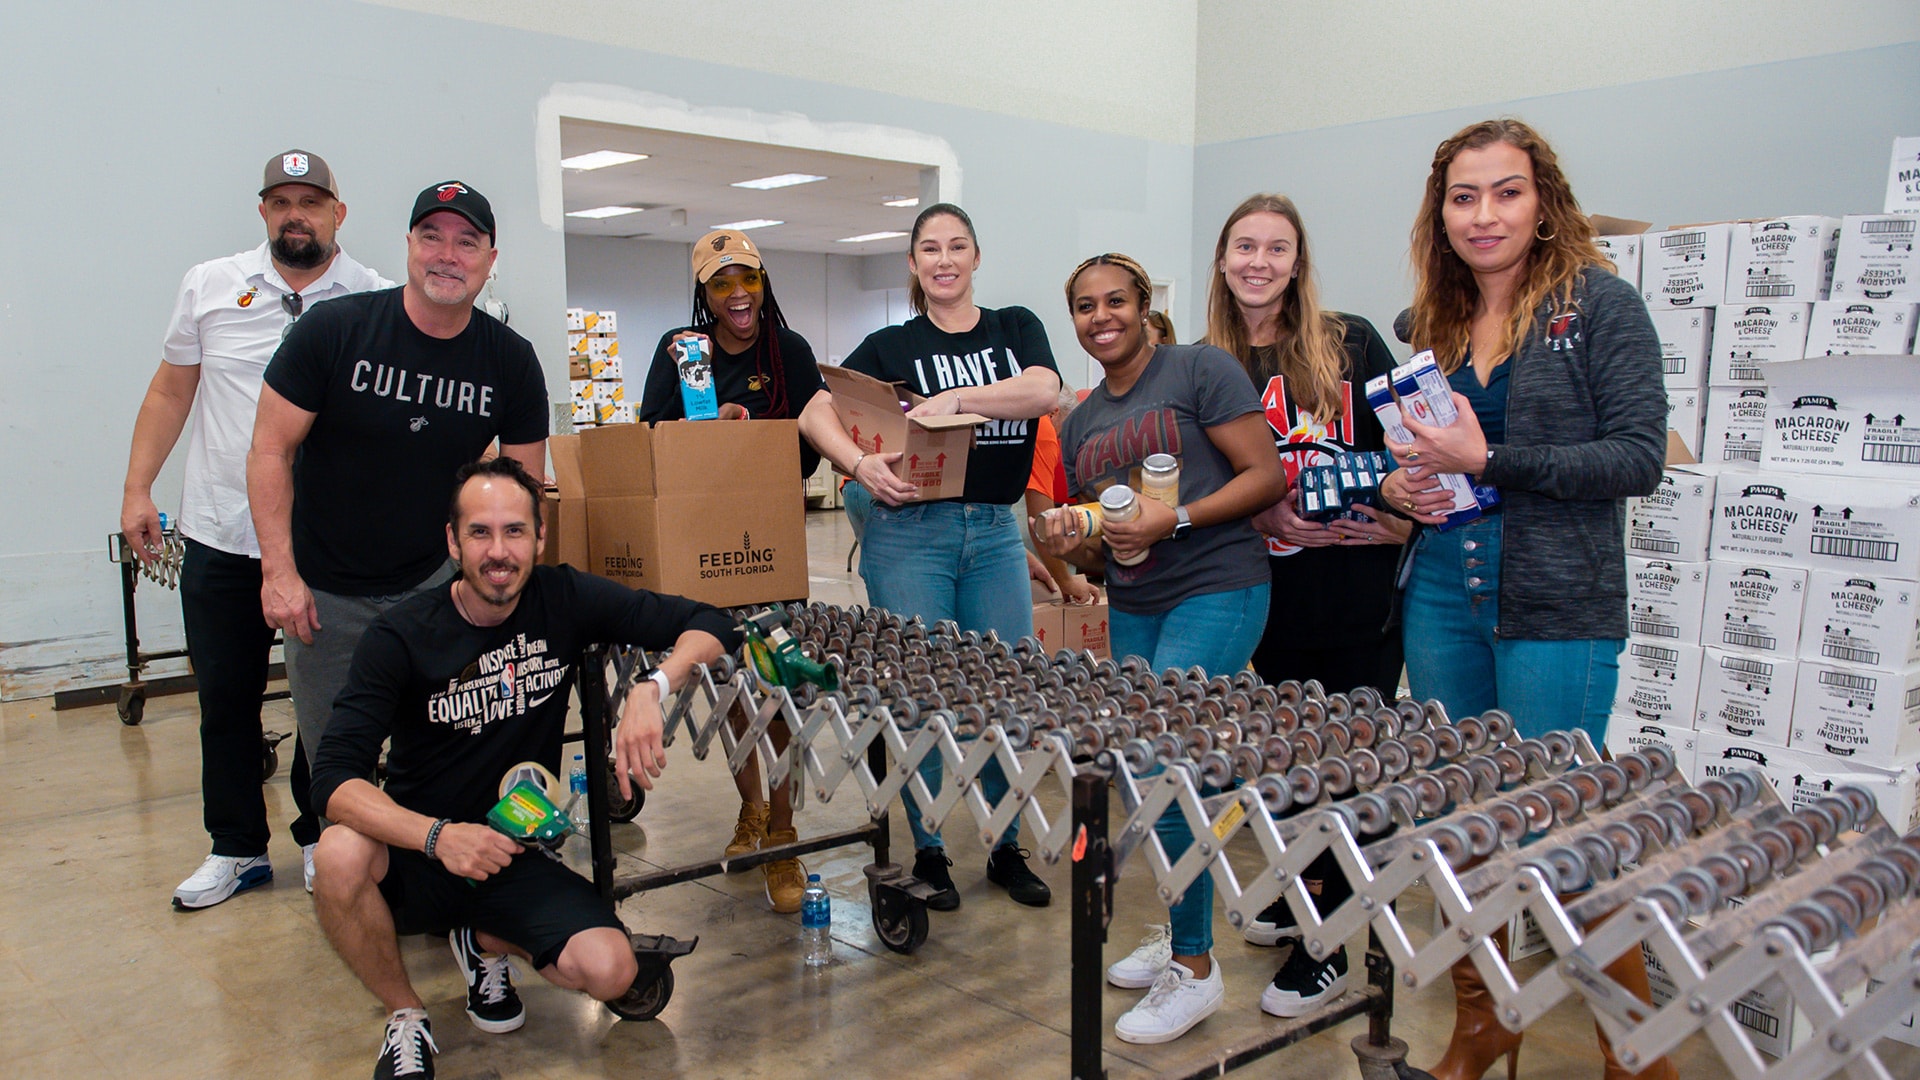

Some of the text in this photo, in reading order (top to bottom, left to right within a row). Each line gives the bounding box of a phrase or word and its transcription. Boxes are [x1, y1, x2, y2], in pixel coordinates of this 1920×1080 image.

[1752, 234, 1797, 245] MACARONI
[1762, 242, 1791, 251] CHEESE
[1864, 268, 1894, 277] CHEESE
[1667, 278, 1694, 287] CHEESE
[1857, 276, 1906, 286] MACARONI
[1662, 283, 1704, 294] MACARONI
[1734, 319, 1778, 329] MACARONI
[1833, 318, 1880, 328] MACARONI
[1843, 326, 1874, 335] CHEESE
[914, 347, 1023, 394] I HAVE A
[351, 360, 494, 417] CULTURE
[1738, 410, 1766, 418] CHEESE
[1775, 416, 1850, 432] MACARONI
[1782, 430, 1840, 444] & CHEESE
[1655, 488, 1681, 499] ARONI
[1750, 487, 1778, 495] PAMPA
[1646, 496, 1675, 506] CHEESE
[1724, 505, 1798, 524] MACARONI
[1731, 518, 1788, 535] & CHEESE
[1759, 535, 1783, 543] FLAVORED
[605, 557, 642, 569] FEEDING
[700, 548, 773, 567] FEEDING
[700, 564, 775, 579] SOUTH FLORIDA
[1636, 573, 1680, 584] MACARONI
[1645, 581, 1674, 592] CHEESE
[1730, 581, 1778, 594] MACARONI
[1740, 589, 1772, 601] CHEESE
[1831, 592, 1884, 607] MACARONI
[1842, 601, 1876, 614] CHEESE
[516, 656, 543, 677] HISTORY
[526, 664, 570, 692] ACTIVAT
[516, 679, 525, 715] EMPOWER
[1634, 690, 1662, 702] CHEESE
[1628, 696, 1672, 710] MACARONI
[483, 699, 514, 724] LOVE
[1725, 704, 1754, 717] CHEESE
[1719, 710, 1765, 726] MACARONI
[1825, 721, 1857, 734] CHEESE
[1817, 728, 1868, 744] MACARONI
[1731, 749, 1760, 760] PAMPA
